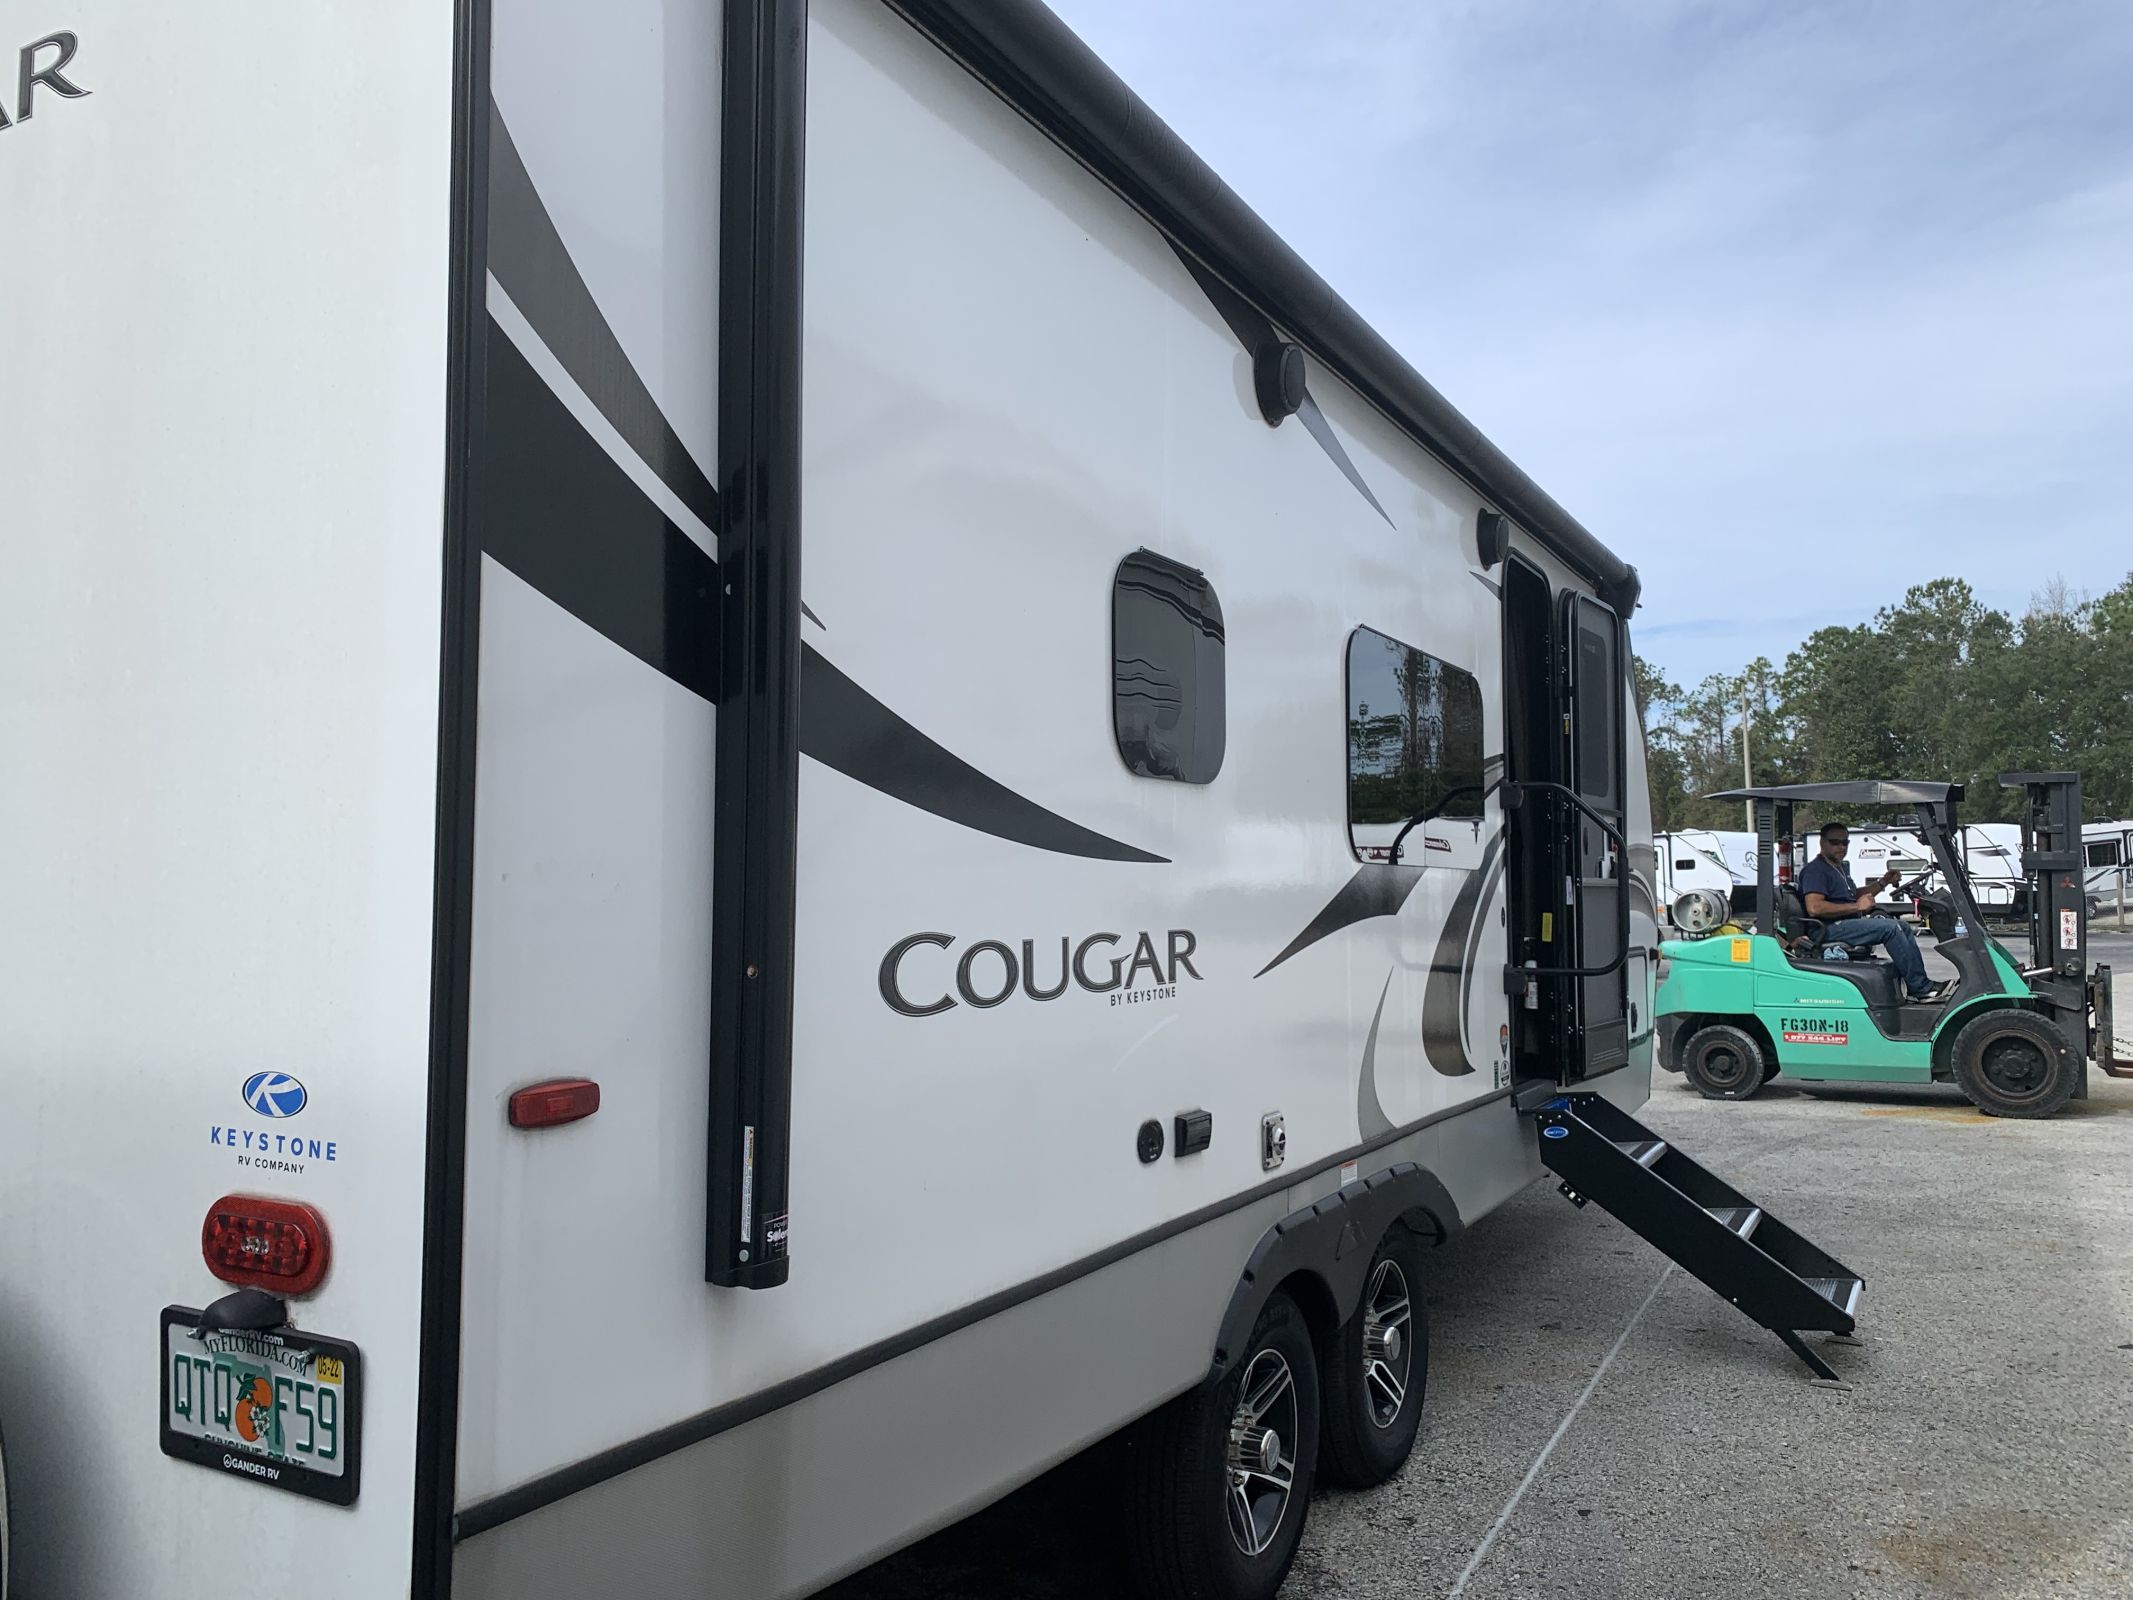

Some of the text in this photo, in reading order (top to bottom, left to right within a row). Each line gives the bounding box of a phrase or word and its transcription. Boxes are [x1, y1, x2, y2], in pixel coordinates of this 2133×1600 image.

[0, 30, 93, 131] R
[878, 928, 1204, 1017] COUGAR
[1110, 986, 1177, 1007] BY KEYSTONE
[1781, 1018, 1849, 1032] FG30N-18
[211, 1126, 337, 1161] KEYSTONE
[238, 1155, 305, 1174] RV COMPANY
[203, 1334, 309, 1377] MYFLORIDA.COM
[174, 1353, 337, 1460] QTQ F59
[232, 1456, 267, 1477] GANDER
[267, 1464, 280, 1481] RV
